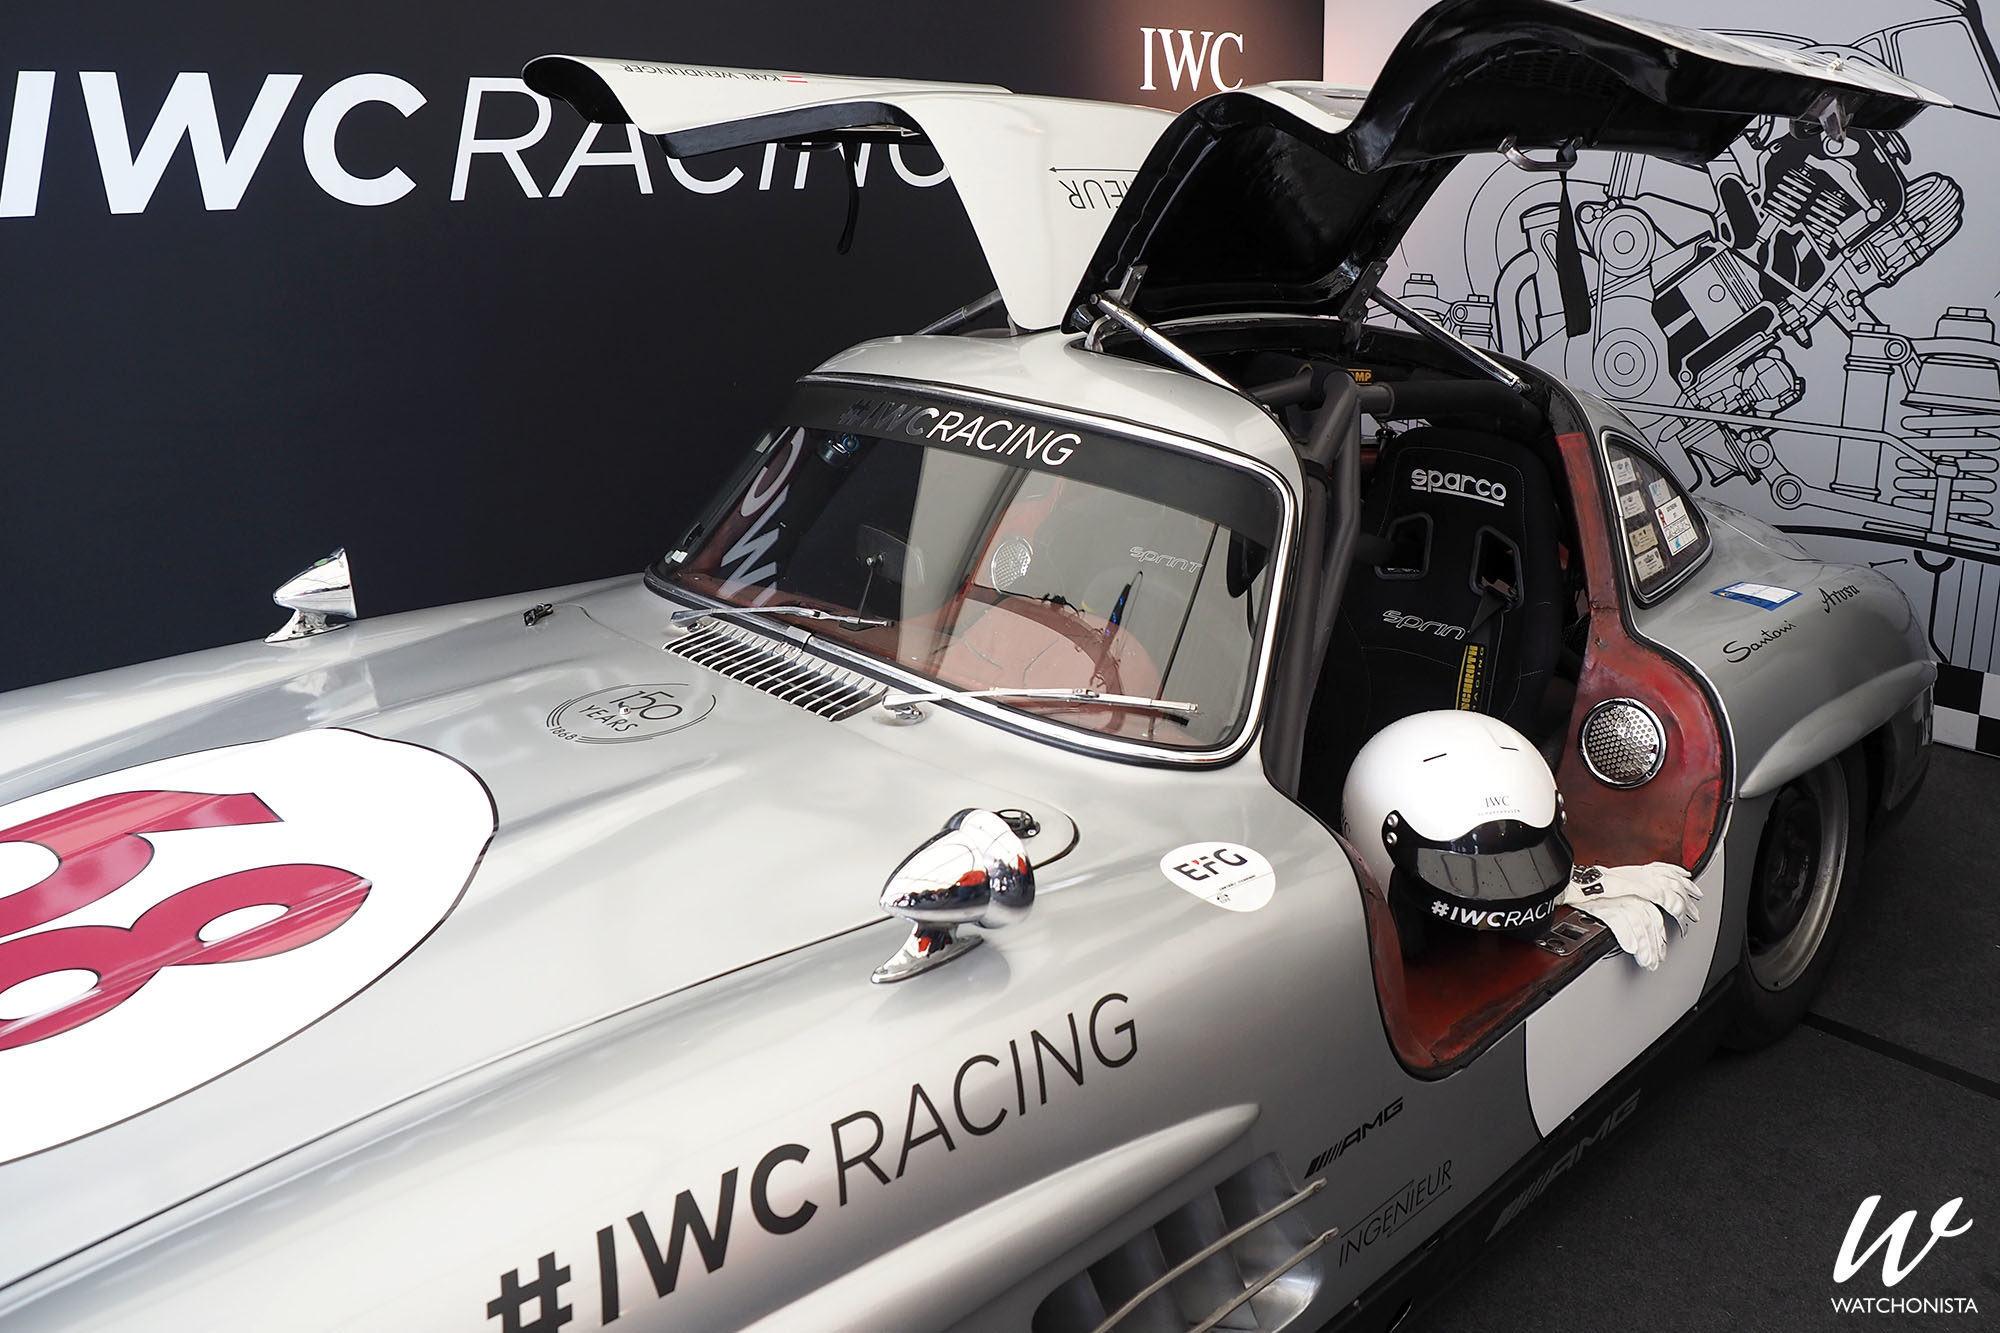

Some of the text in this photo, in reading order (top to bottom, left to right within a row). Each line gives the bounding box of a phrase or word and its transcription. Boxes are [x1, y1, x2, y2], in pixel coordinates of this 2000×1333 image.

[620, 64, 781, 82] KARL WENDLINGER
[1140, 27, 1243, 92] IWC
[1411, 468, 1507, 501] sparco
[1382, 609, 1470, 641] sprin
[1722, 620, 1797, 663] Santoni
[579, 704, 638, 732] YEARS
[609, 691, 683, 720] 150
[550, 726, 578, 741] 1868
[1172, 848, 1248, 881] EFG
[1338, 1159, 1452, 1269] INGENIEUR
